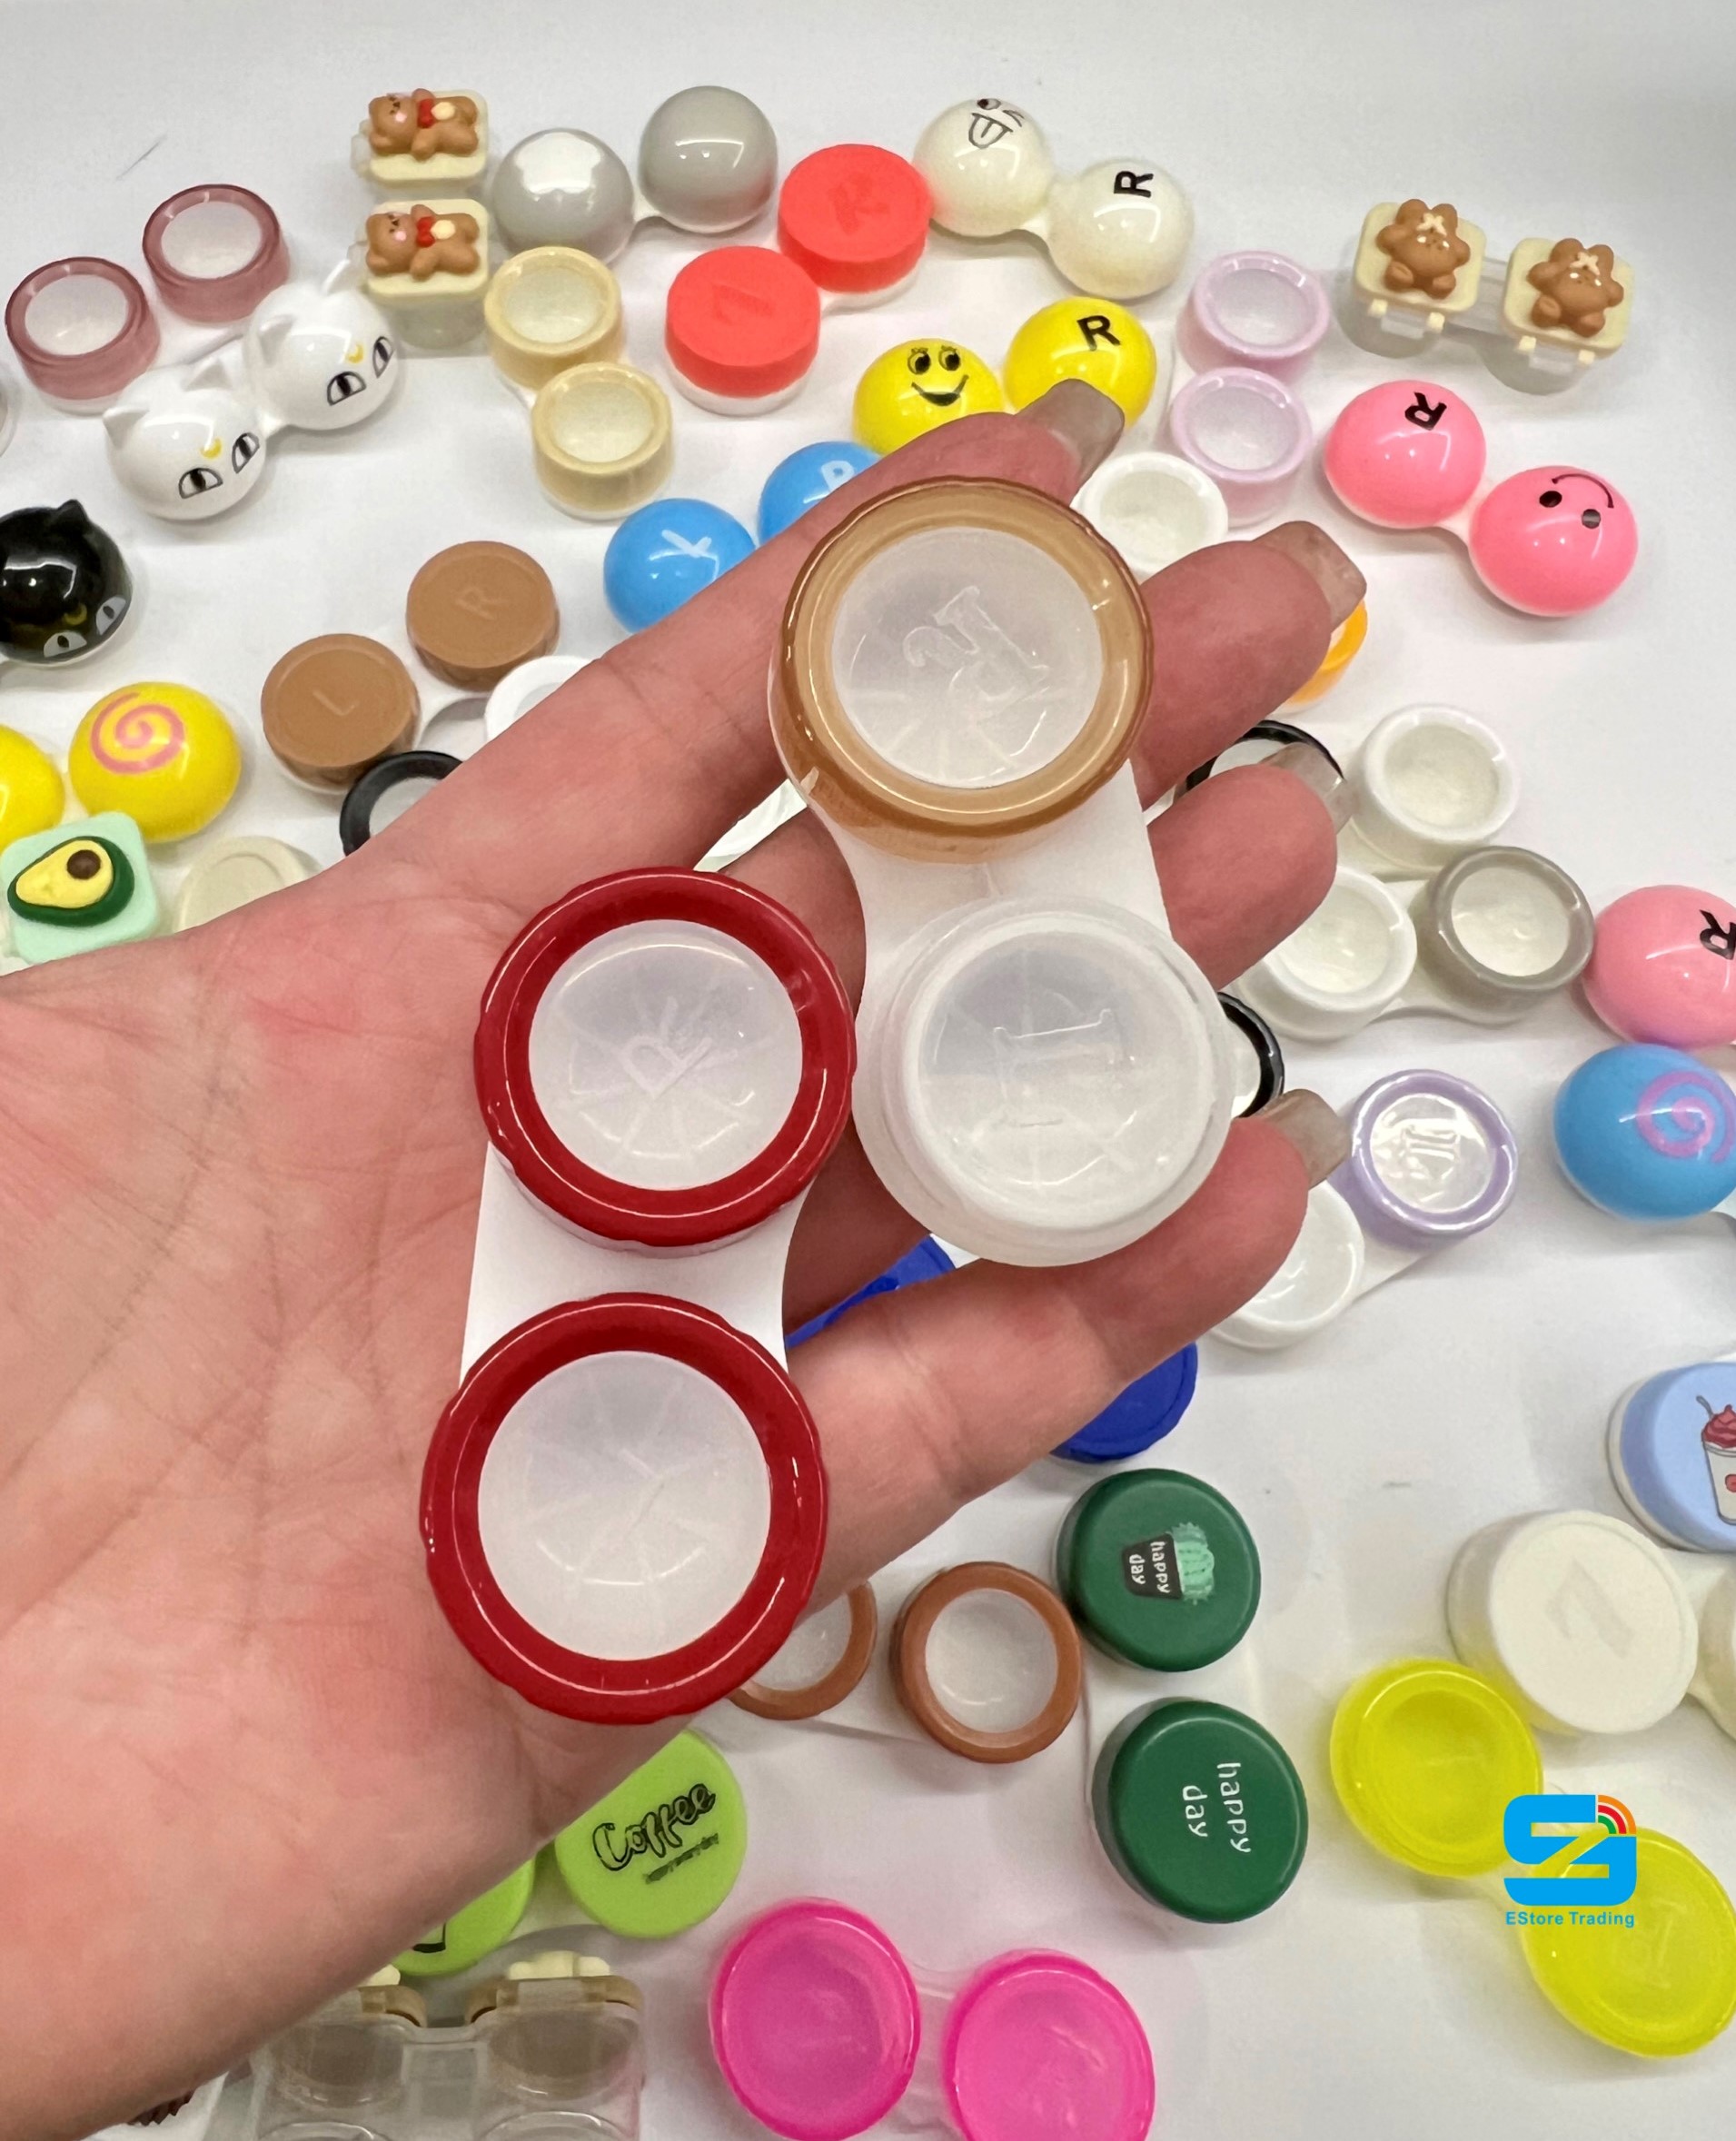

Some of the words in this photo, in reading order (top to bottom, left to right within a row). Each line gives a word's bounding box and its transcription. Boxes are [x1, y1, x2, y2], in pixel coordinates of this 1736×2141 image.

[1114, 170, 1154, 198] R
[1076, 315, 1121, 352] R
[1404, 392, 1447, 431] R
[1698, 909, 1736, 960] R
[1128, 1553, 1146, 1585] day
[1150, 1541, 1171, 1594] happy
[592, 1783, 717, 1872] Coffee
[1182, 1785, 1208, 1838] day
[1216, 1762, 1252, 1853] happy
